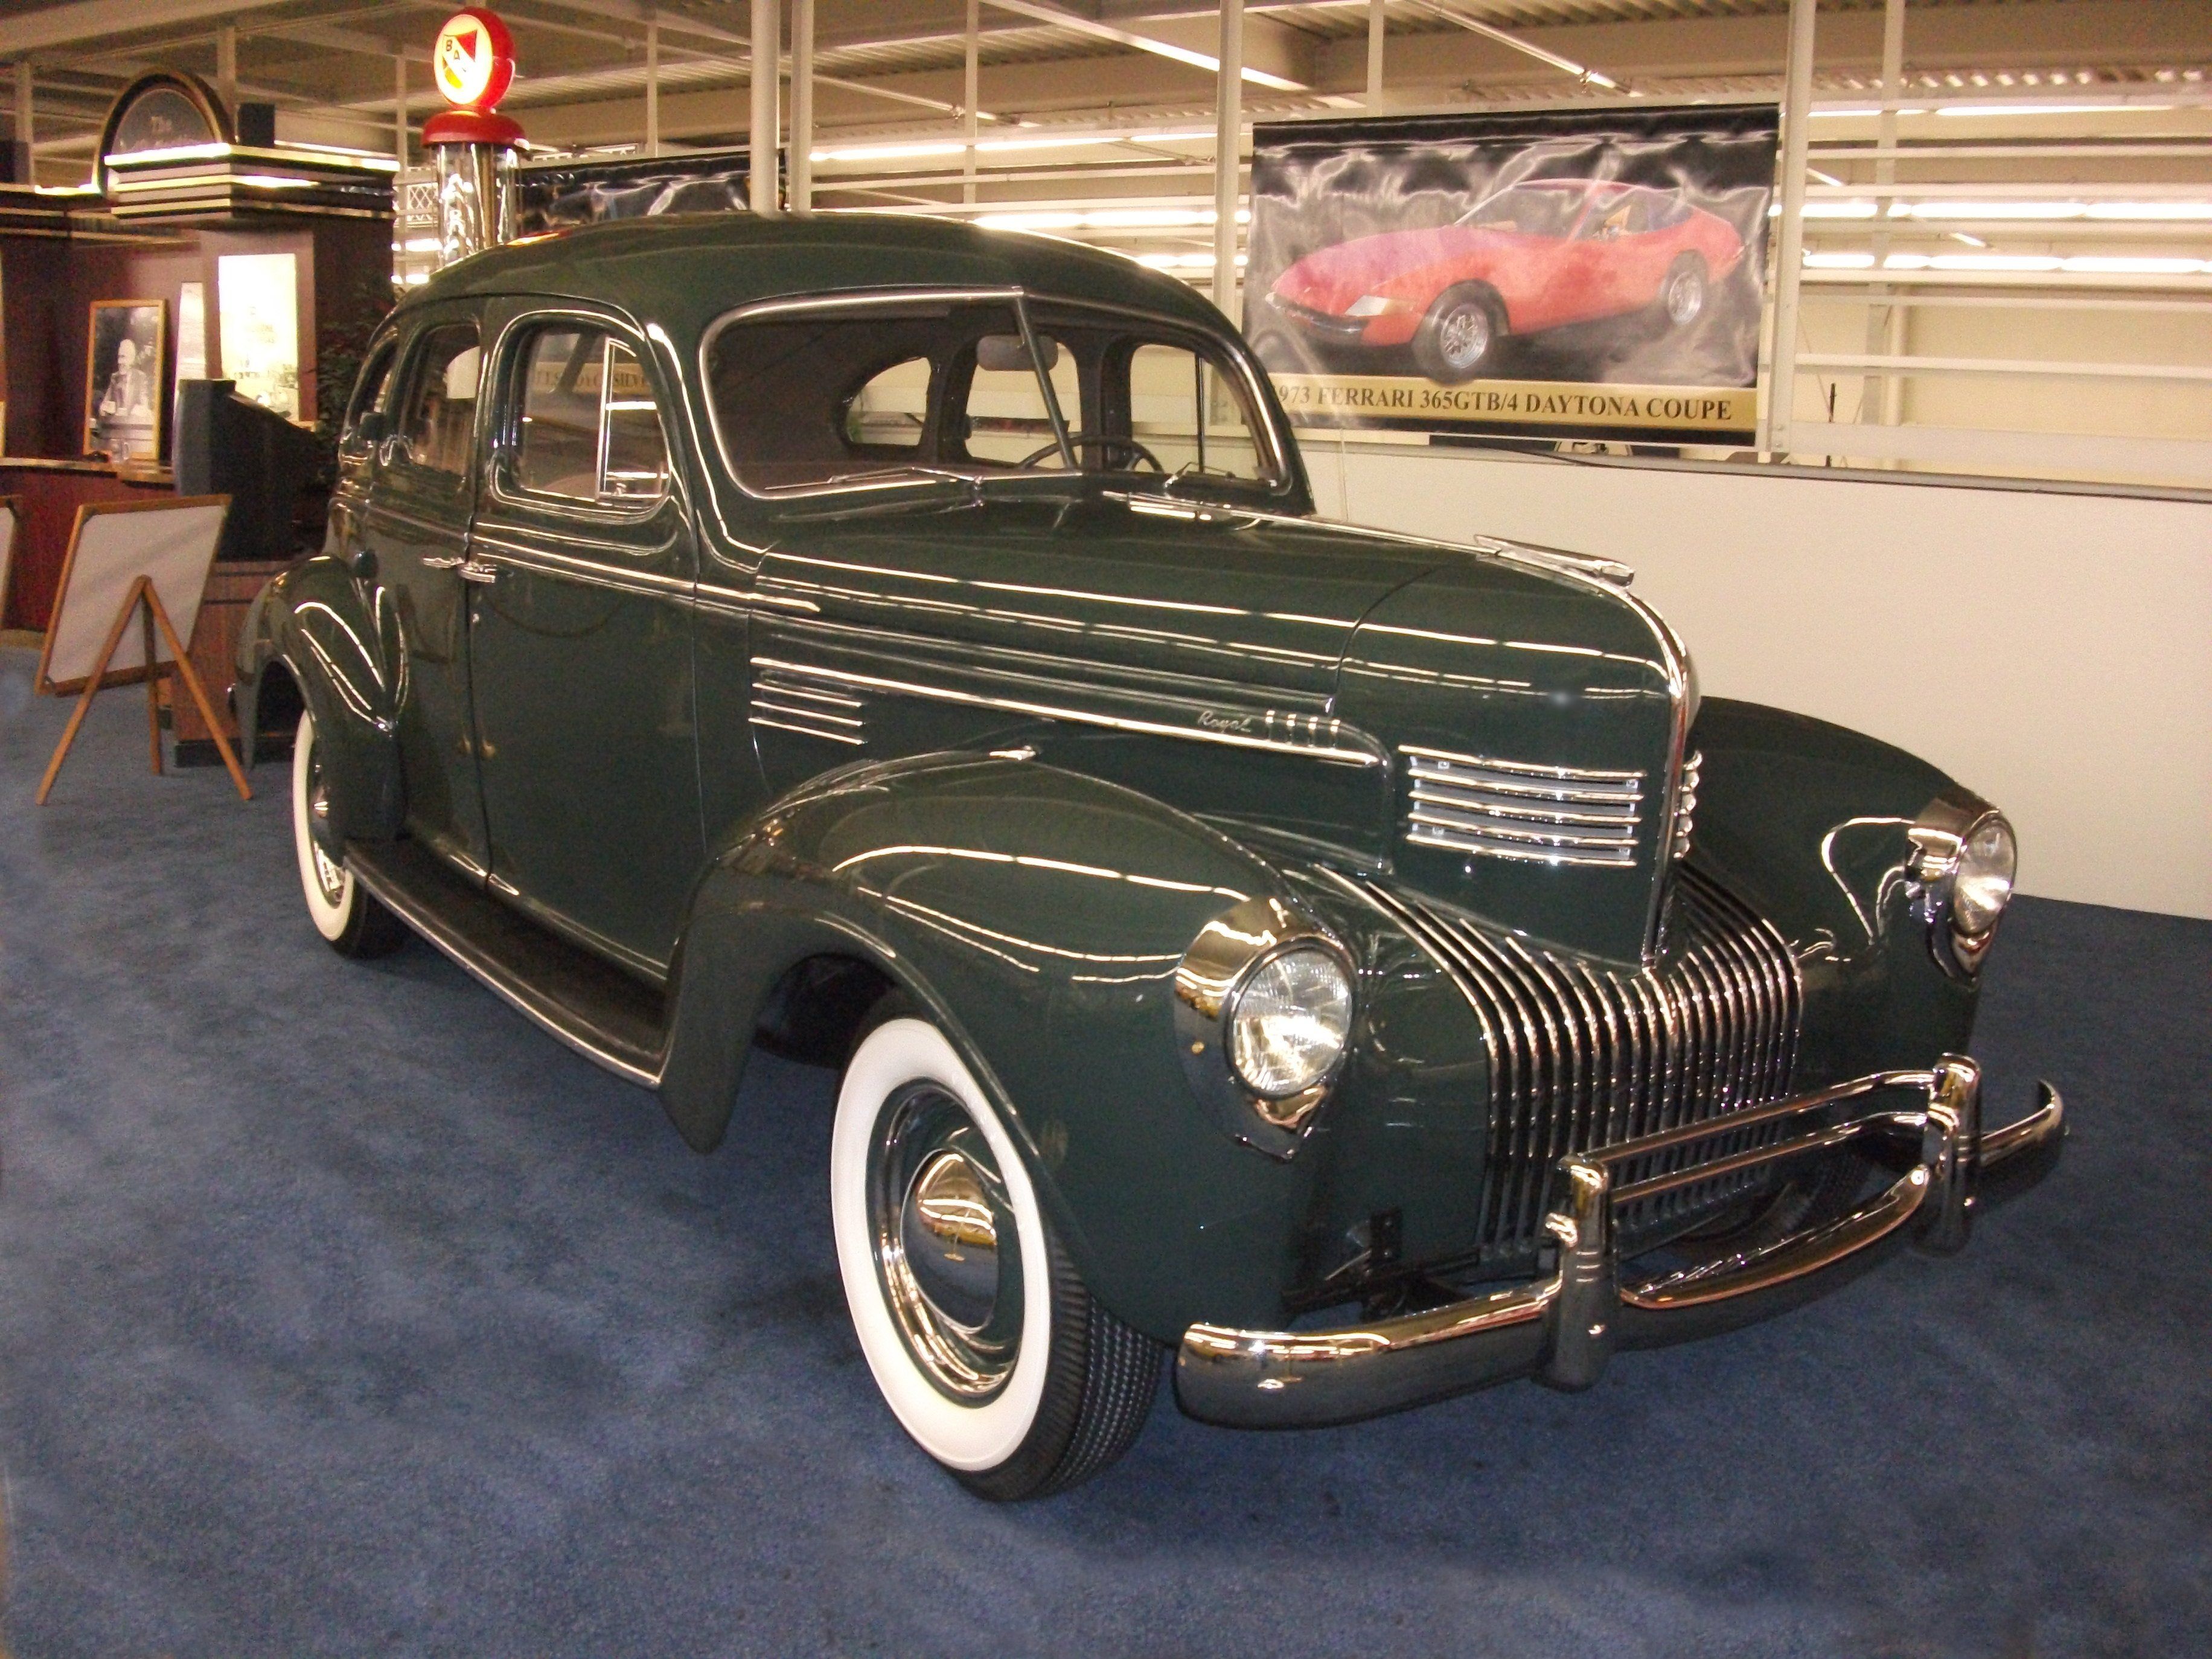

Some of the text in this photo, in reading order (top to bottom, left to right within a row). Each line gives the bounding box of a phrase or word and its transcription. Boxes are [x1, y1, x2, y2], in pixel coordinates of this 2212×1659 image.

[1273, 385, 1732, 421] 973 FERRARI 365GTB/4 DAYTONA COUPE
[1198, 711, 1251, 734] Royal
